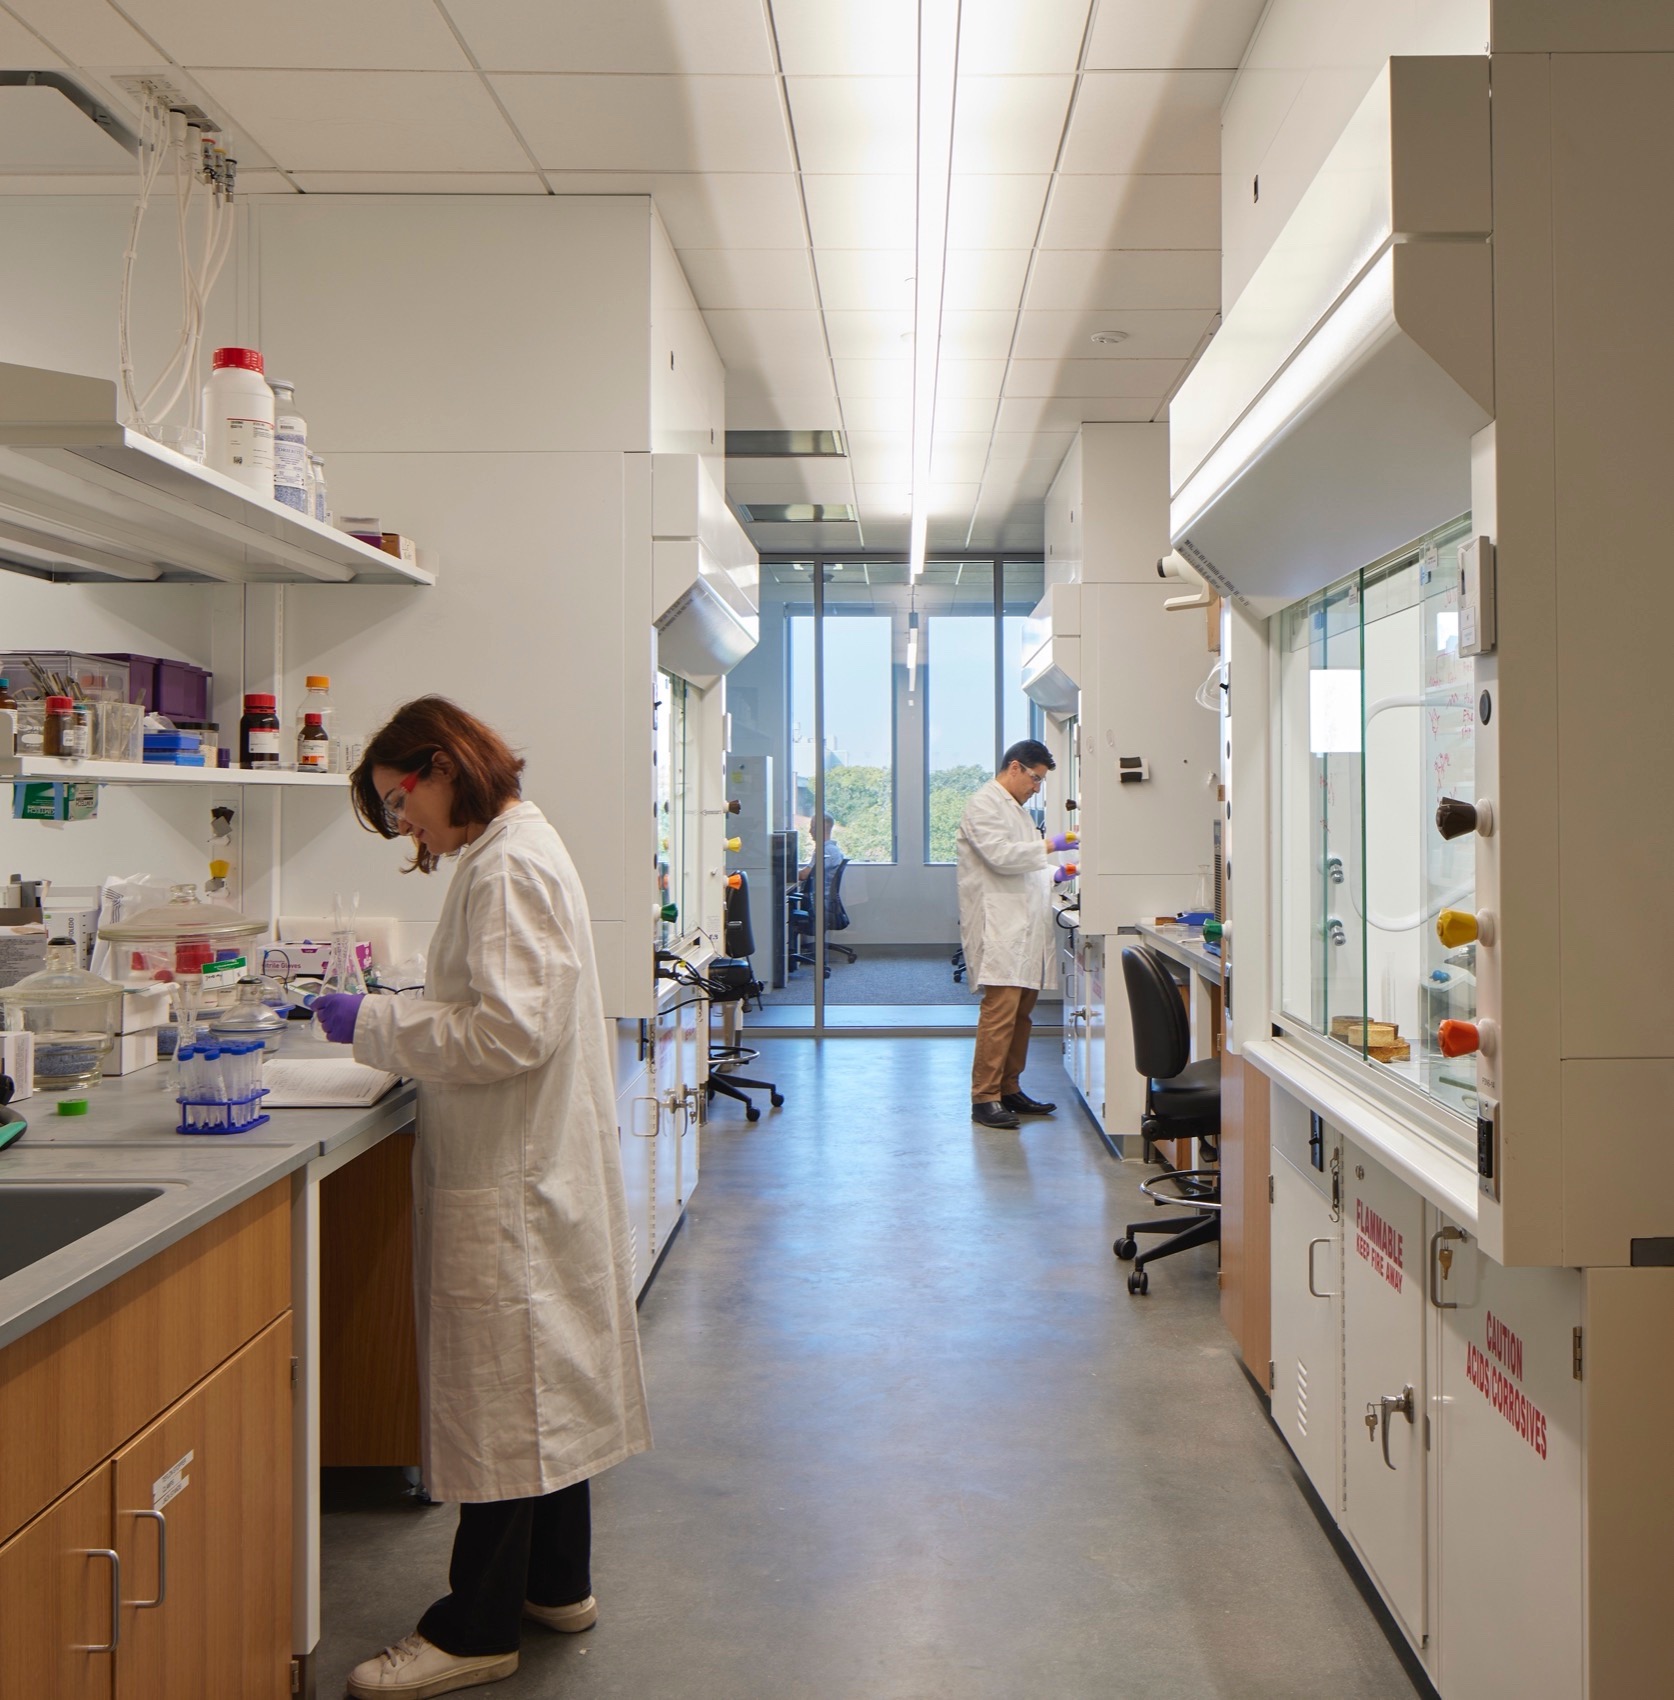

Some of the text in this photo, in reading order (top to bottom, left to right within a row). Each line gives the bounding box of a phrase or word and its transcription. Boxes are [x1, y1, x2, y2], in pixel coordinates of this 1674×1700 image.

[1356, 1198, 1403, 1269] FLAMMABLE
[1356, 1233, 1403, 1294] KEEP FIRE AWAY
[1486, 1310, 1523, 1382] CAUTION
[1466, 1341, 1547, 1461] ACIDS/CORROSIVES
